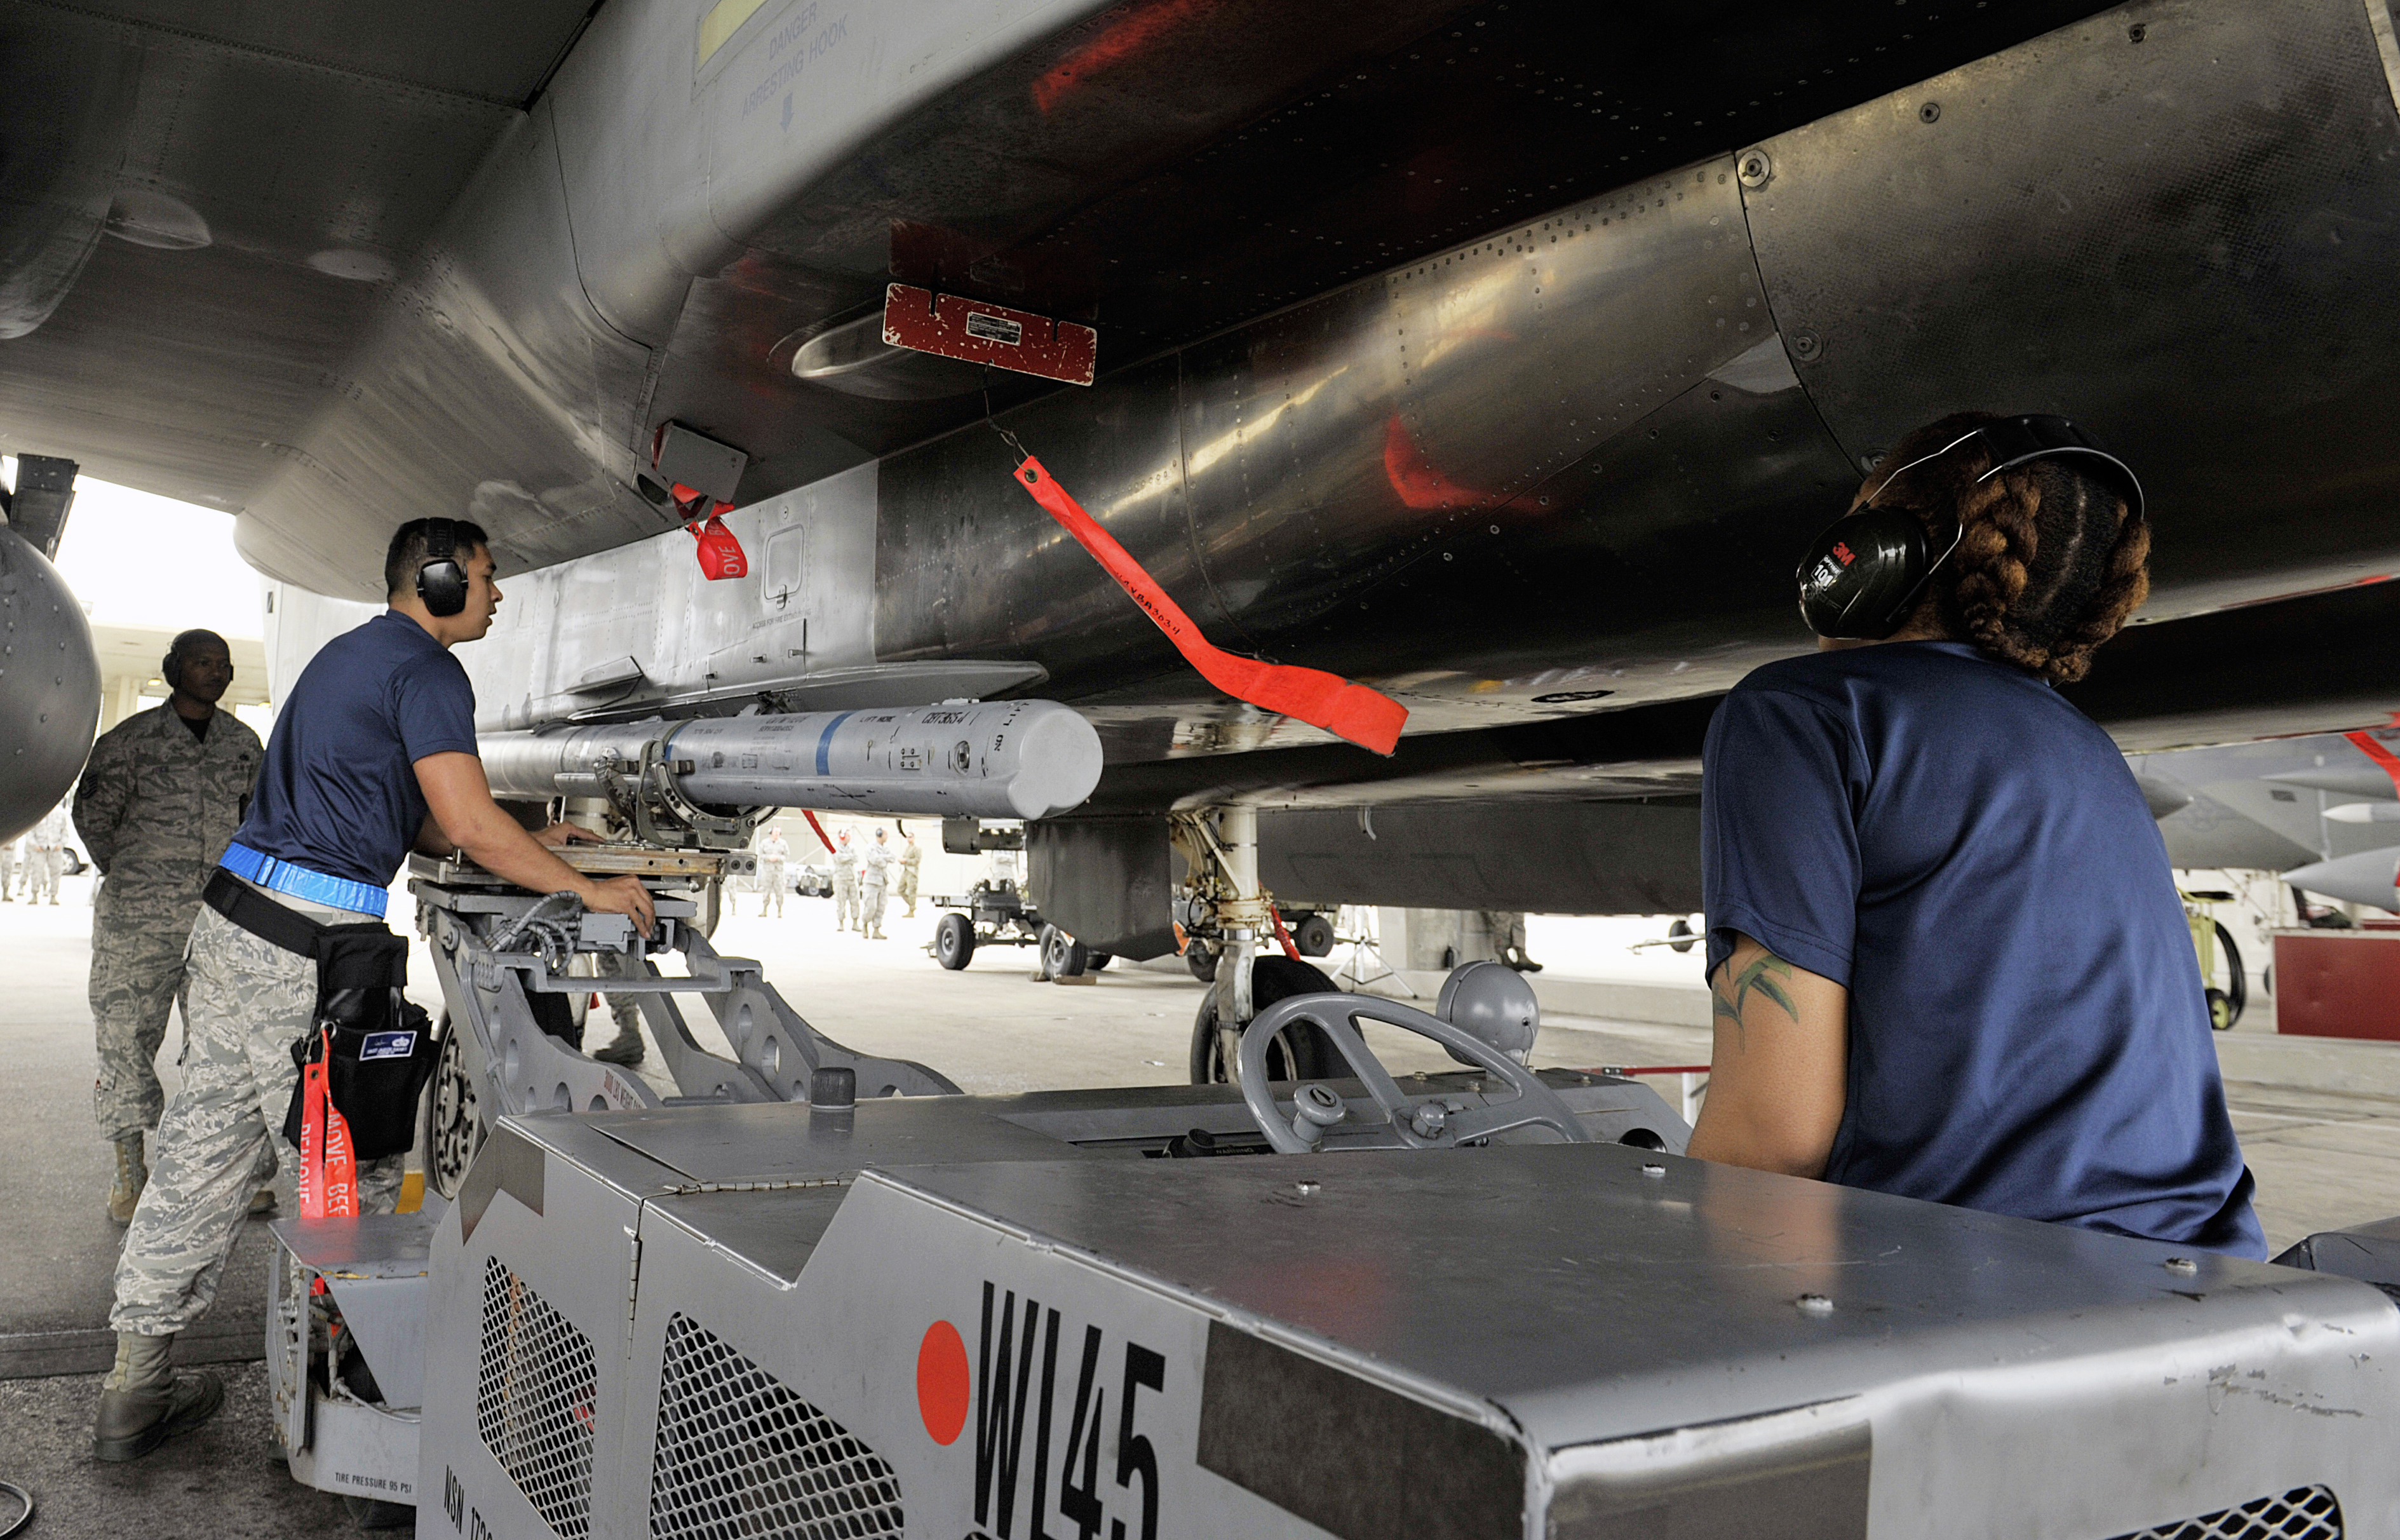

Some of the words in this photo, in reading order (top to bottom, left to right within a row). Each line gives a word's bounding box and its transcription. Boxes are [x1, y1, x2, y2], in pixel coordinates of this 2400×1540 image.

[769, 2, 817, 61] DANGER
[742, 56, 804, 121] ARRESTING
[809, 14, 848, 63] HOOK
[718, 546, 740, 578] OVE
[1814, 564, 1833, 588] 101
[1833, 542, 1856, 566] 3M
[994, 734, 1003, 751] NO
[327, 1090, 347, 1168] MOVE
[974, 1280, 1166, 1540] WL45
[335, 1472, 350, 1484] TIRE
[352, 1475, 387, 1490] PRESSURE
[389, 1480, 398, 1492] 95
[400, 1482, 412, 1494] PSI
[444, 1464, 464, 1534] NSN
[471, 1507, 494, 1540] 17
